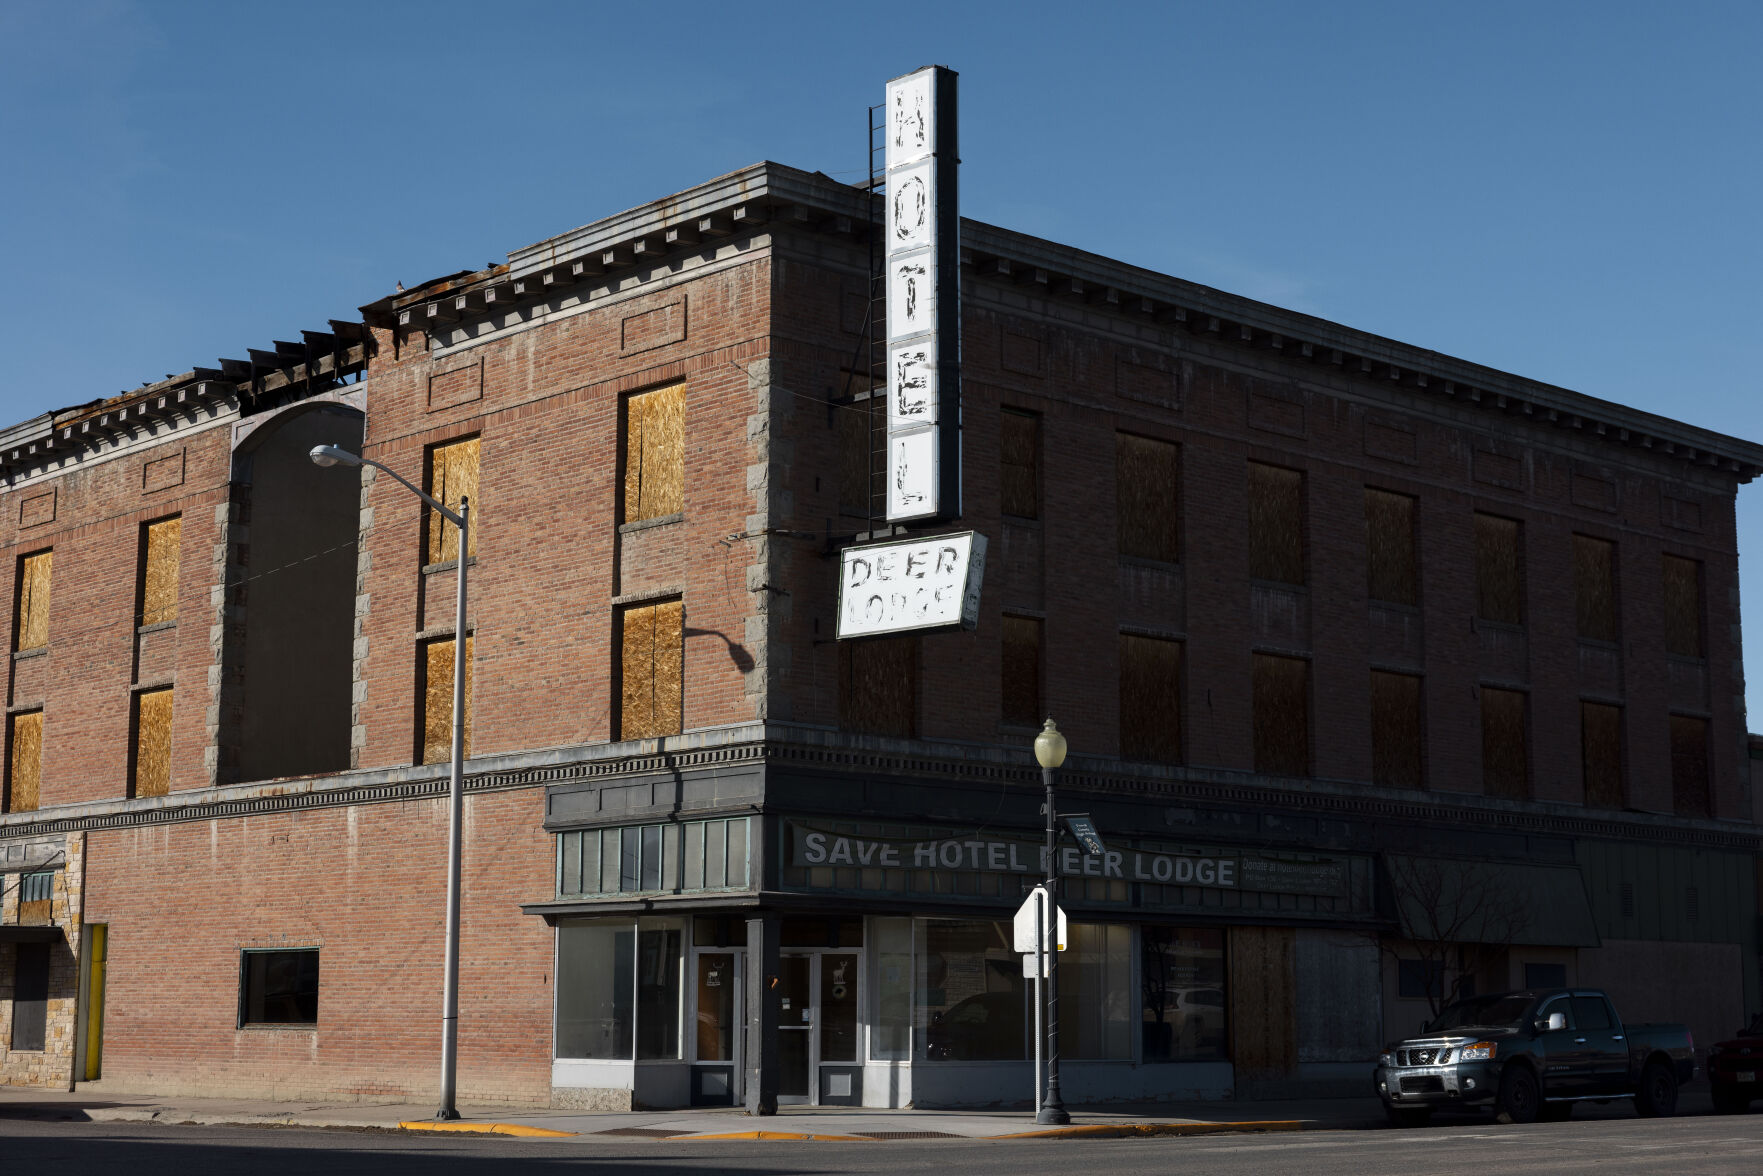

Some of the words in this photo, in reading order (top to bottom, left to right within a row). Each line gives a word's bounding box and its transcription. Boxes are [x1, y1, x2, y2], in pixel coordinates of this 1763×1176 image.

[894, 88, 927, 506] HOTEL
[851, 546, 959, 588] DEER
[805, 833, 901, 866] SAVE
[913, 841, 1028, 871] HOTEL
[1134, 854, 1235, 887] LODGE
